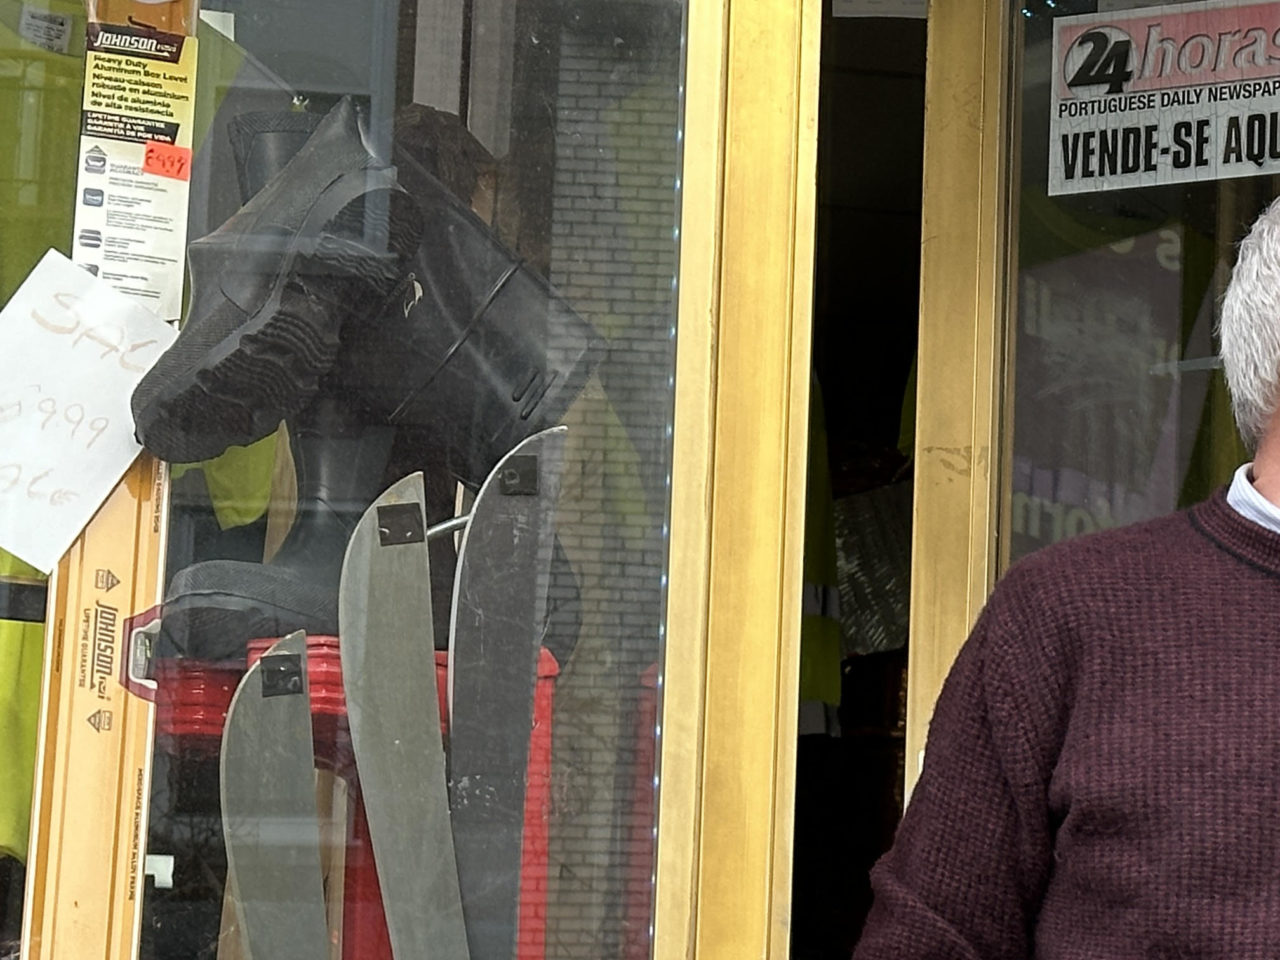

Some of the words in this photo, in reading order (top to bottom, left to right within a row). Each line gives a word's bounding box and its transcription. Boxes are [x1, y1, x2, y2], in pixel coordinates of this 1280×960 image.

[1067, 31, 1134, 96] 24
[1058, 94, 1156, 118] PORTUGUESE
[1160, 88, 1203, 108] DAILY
[1060, 120, 1210, 181] VENDE-SE
